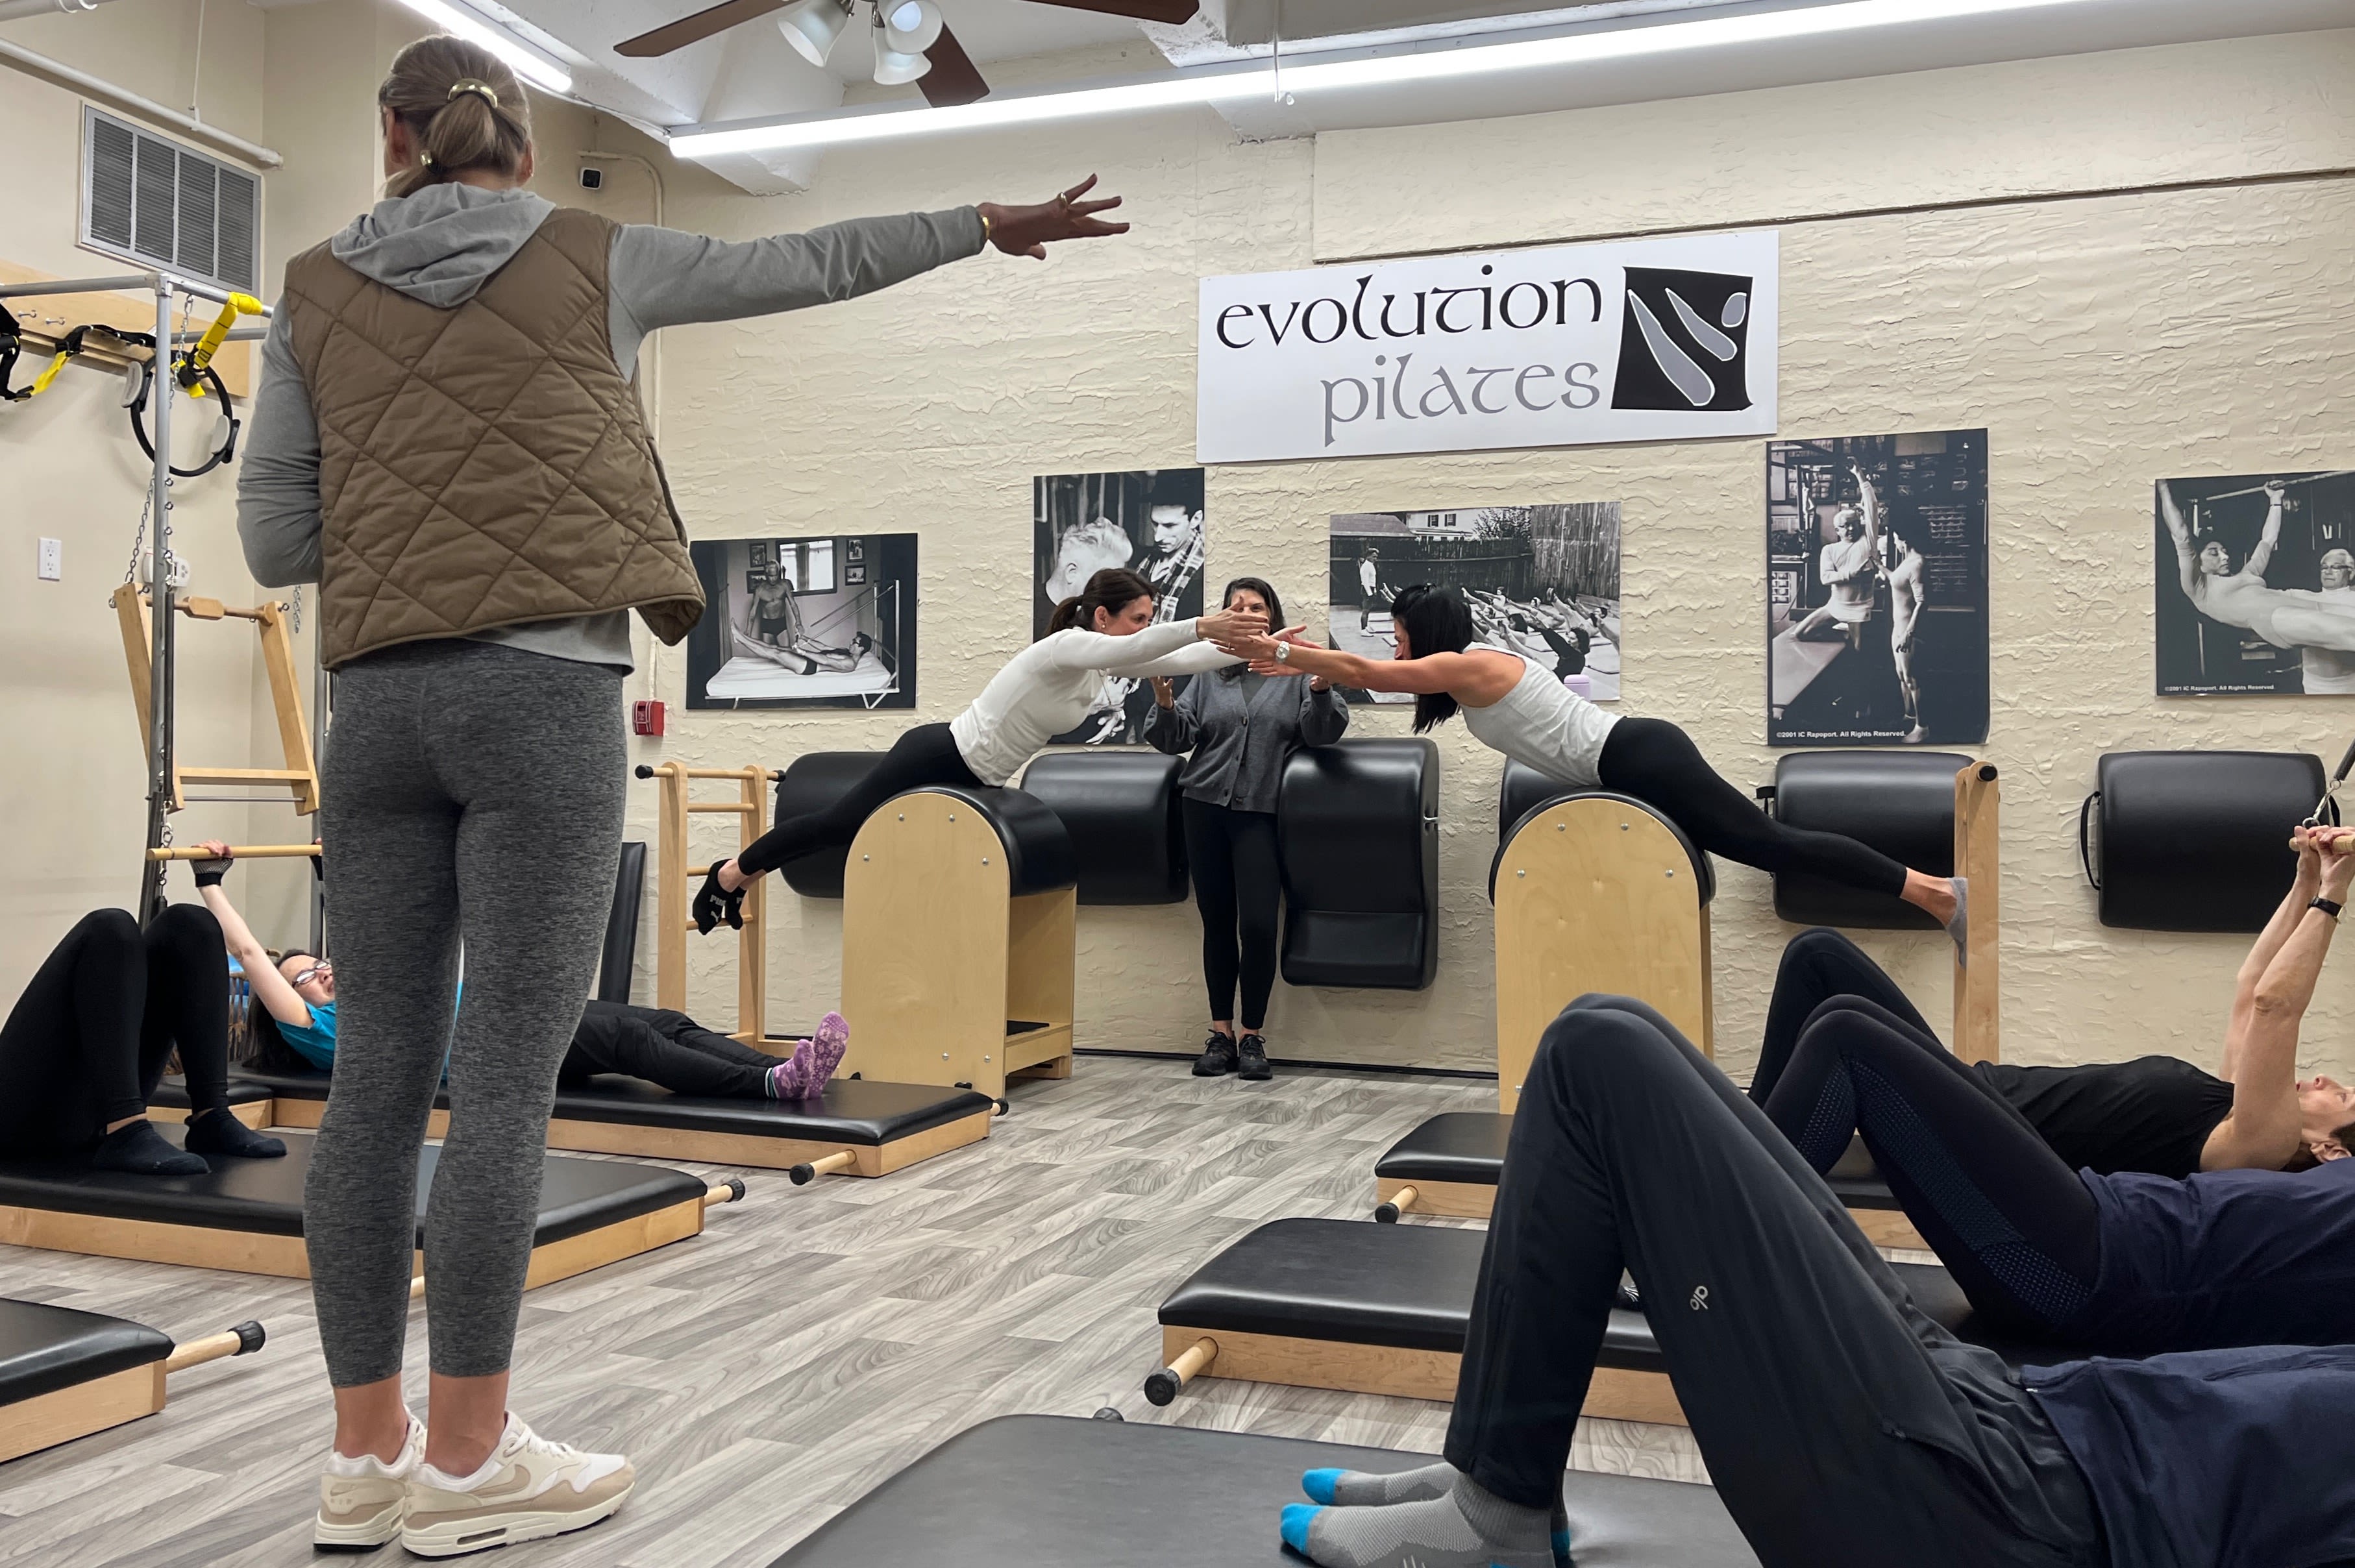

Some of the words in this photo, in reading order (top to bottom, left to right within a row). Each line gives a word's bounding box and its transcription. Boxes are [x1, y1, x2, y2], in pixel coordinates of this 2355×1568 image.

[1216, 263, 1602, 349] evolution
[1320, 352, 1601, 448] pilates
[1690, 1286, 1708, 1310] alo
